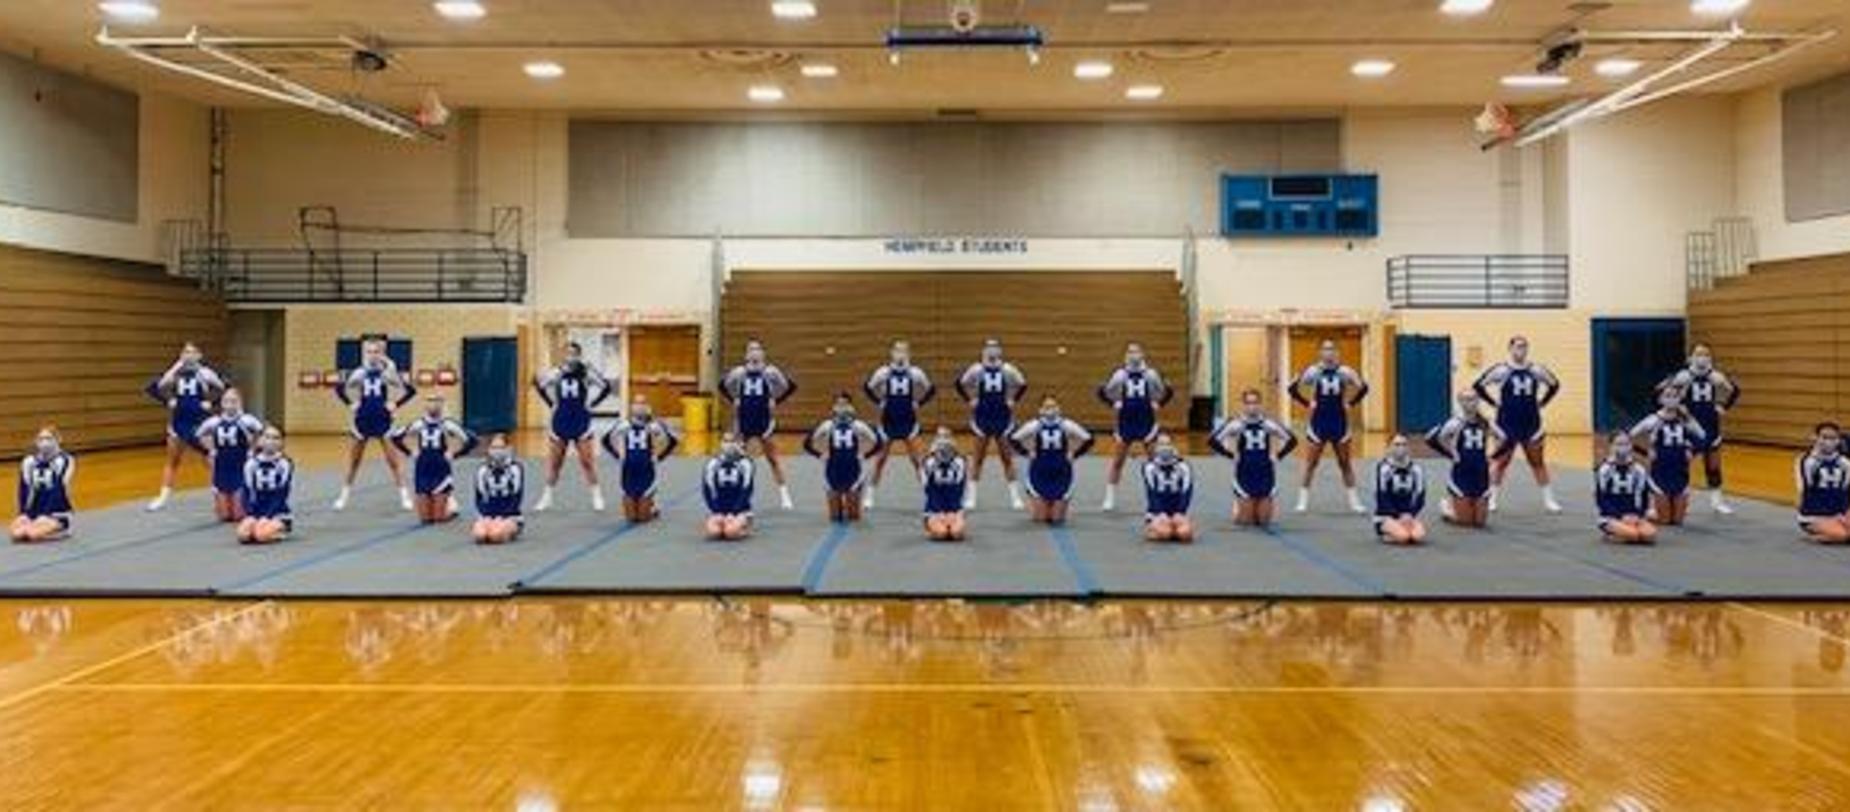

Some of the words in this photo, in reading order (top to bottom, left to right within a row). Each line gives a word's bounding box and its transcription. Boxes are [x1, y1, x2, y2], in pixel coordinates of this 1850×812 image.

[178, 379, 198, 396] H
[364, 379, 383, 396] H
[561, 379, 578, 397] H
[744, 378, 763, 395] H
[891, 378, 909, 395] H
[984, 374, 1001, 392] H
[1127, 379, 1146, 396] H
[1321, 378, 1340, 395] H
[1512, 377, 1533, 395] H
[1692, 383, 1712, 401] H
[217, 427, 237, 446] H
[421, 430, 440, 448] H
[628, 431, 646, 449] H
[834, 430, 852, 448] H
[1042, 431, 1061, 448] H
[1246, 432, 1265, 449] H
[1464, 430, 1483, 448] H
[1663, 426, 1684, 444] H
[32, 468, 53, 488] H
[255, 469, 277, 489] H
[718, 467, 738, 484] H
[1157, 473, 1179, 491] H
[1393, 473, 1413, 492] H
[1612, 473, 1633, 494] H
[1819, 467, 1841, 488] H
[489, 476, 510, 496] H
